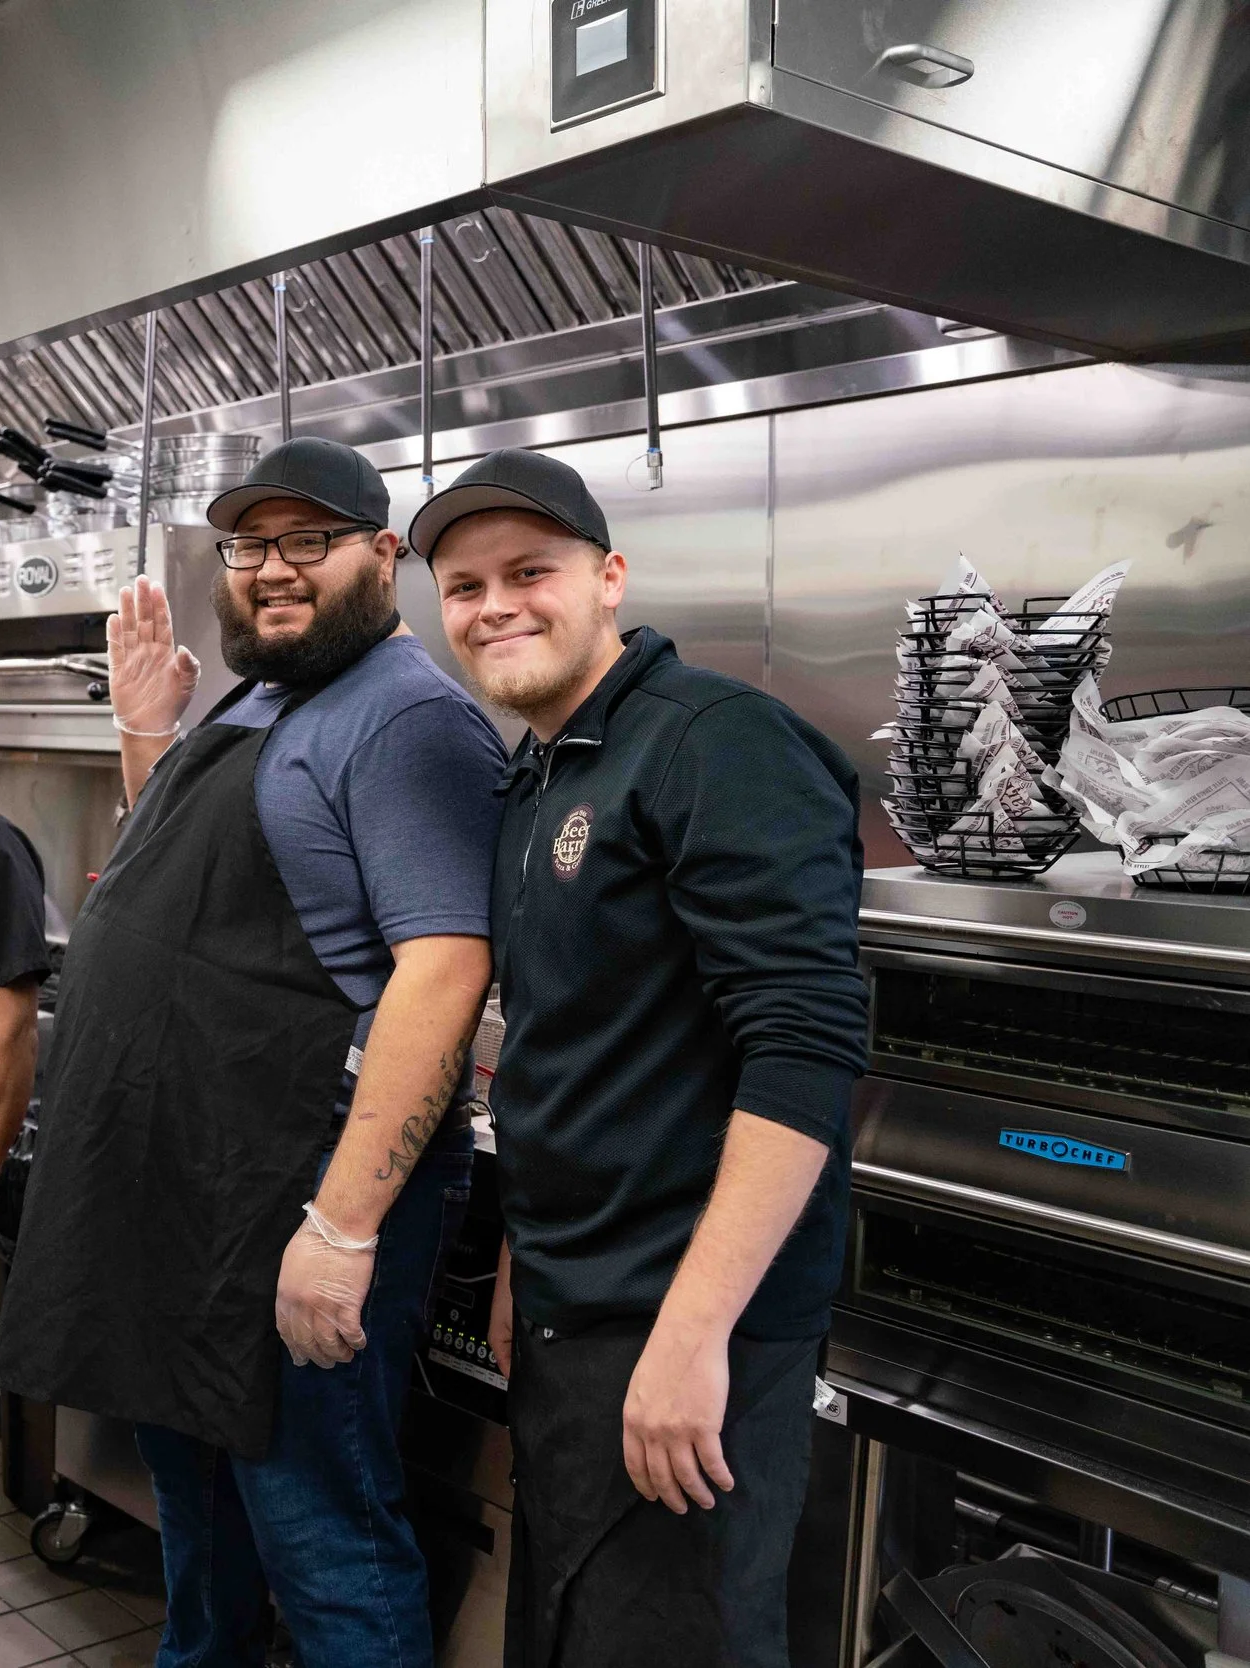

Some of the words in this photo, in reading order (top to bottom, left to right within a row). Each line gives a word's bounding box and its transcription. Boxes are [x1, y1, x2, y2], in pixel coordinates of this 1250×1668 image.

[17, 565, 52, 585] ROYAL
[560, 825, 591, 839] Beer
[553, 838, 586, 855] Barre
[1005, 1133, 1116, 1165] TURBOCHEF
